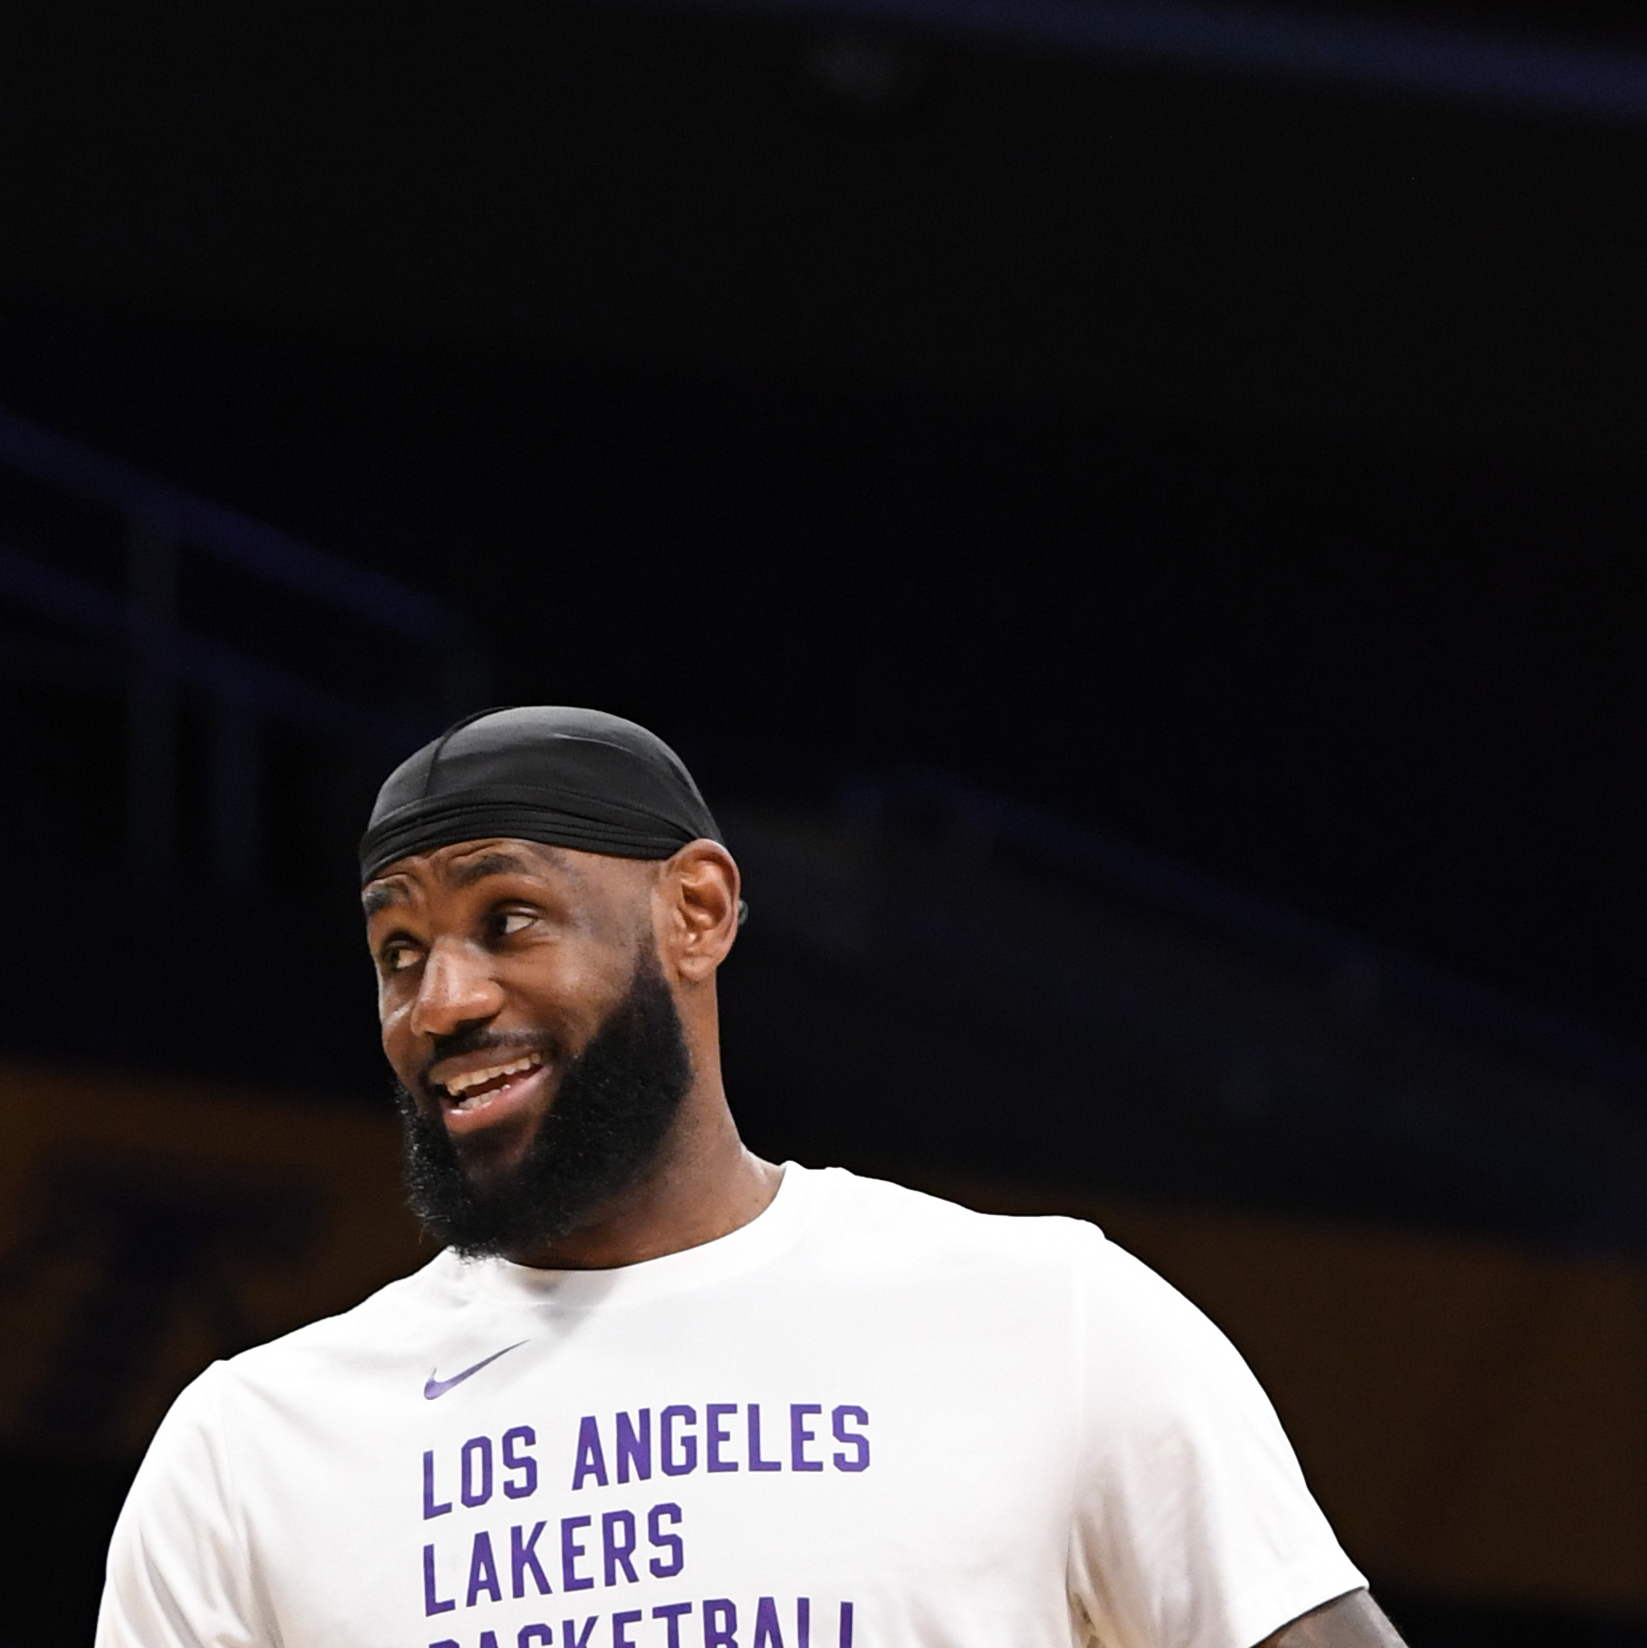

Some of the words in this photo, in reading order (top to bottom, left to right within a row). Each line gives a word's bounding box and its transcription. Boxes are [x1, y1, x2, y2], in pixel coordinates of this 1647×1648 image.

[422, 1425, 538, 1520] LOS
[571, 1403, 871, 1491] ANGELES
[422, 1502, 684, 1617] LAKERS
